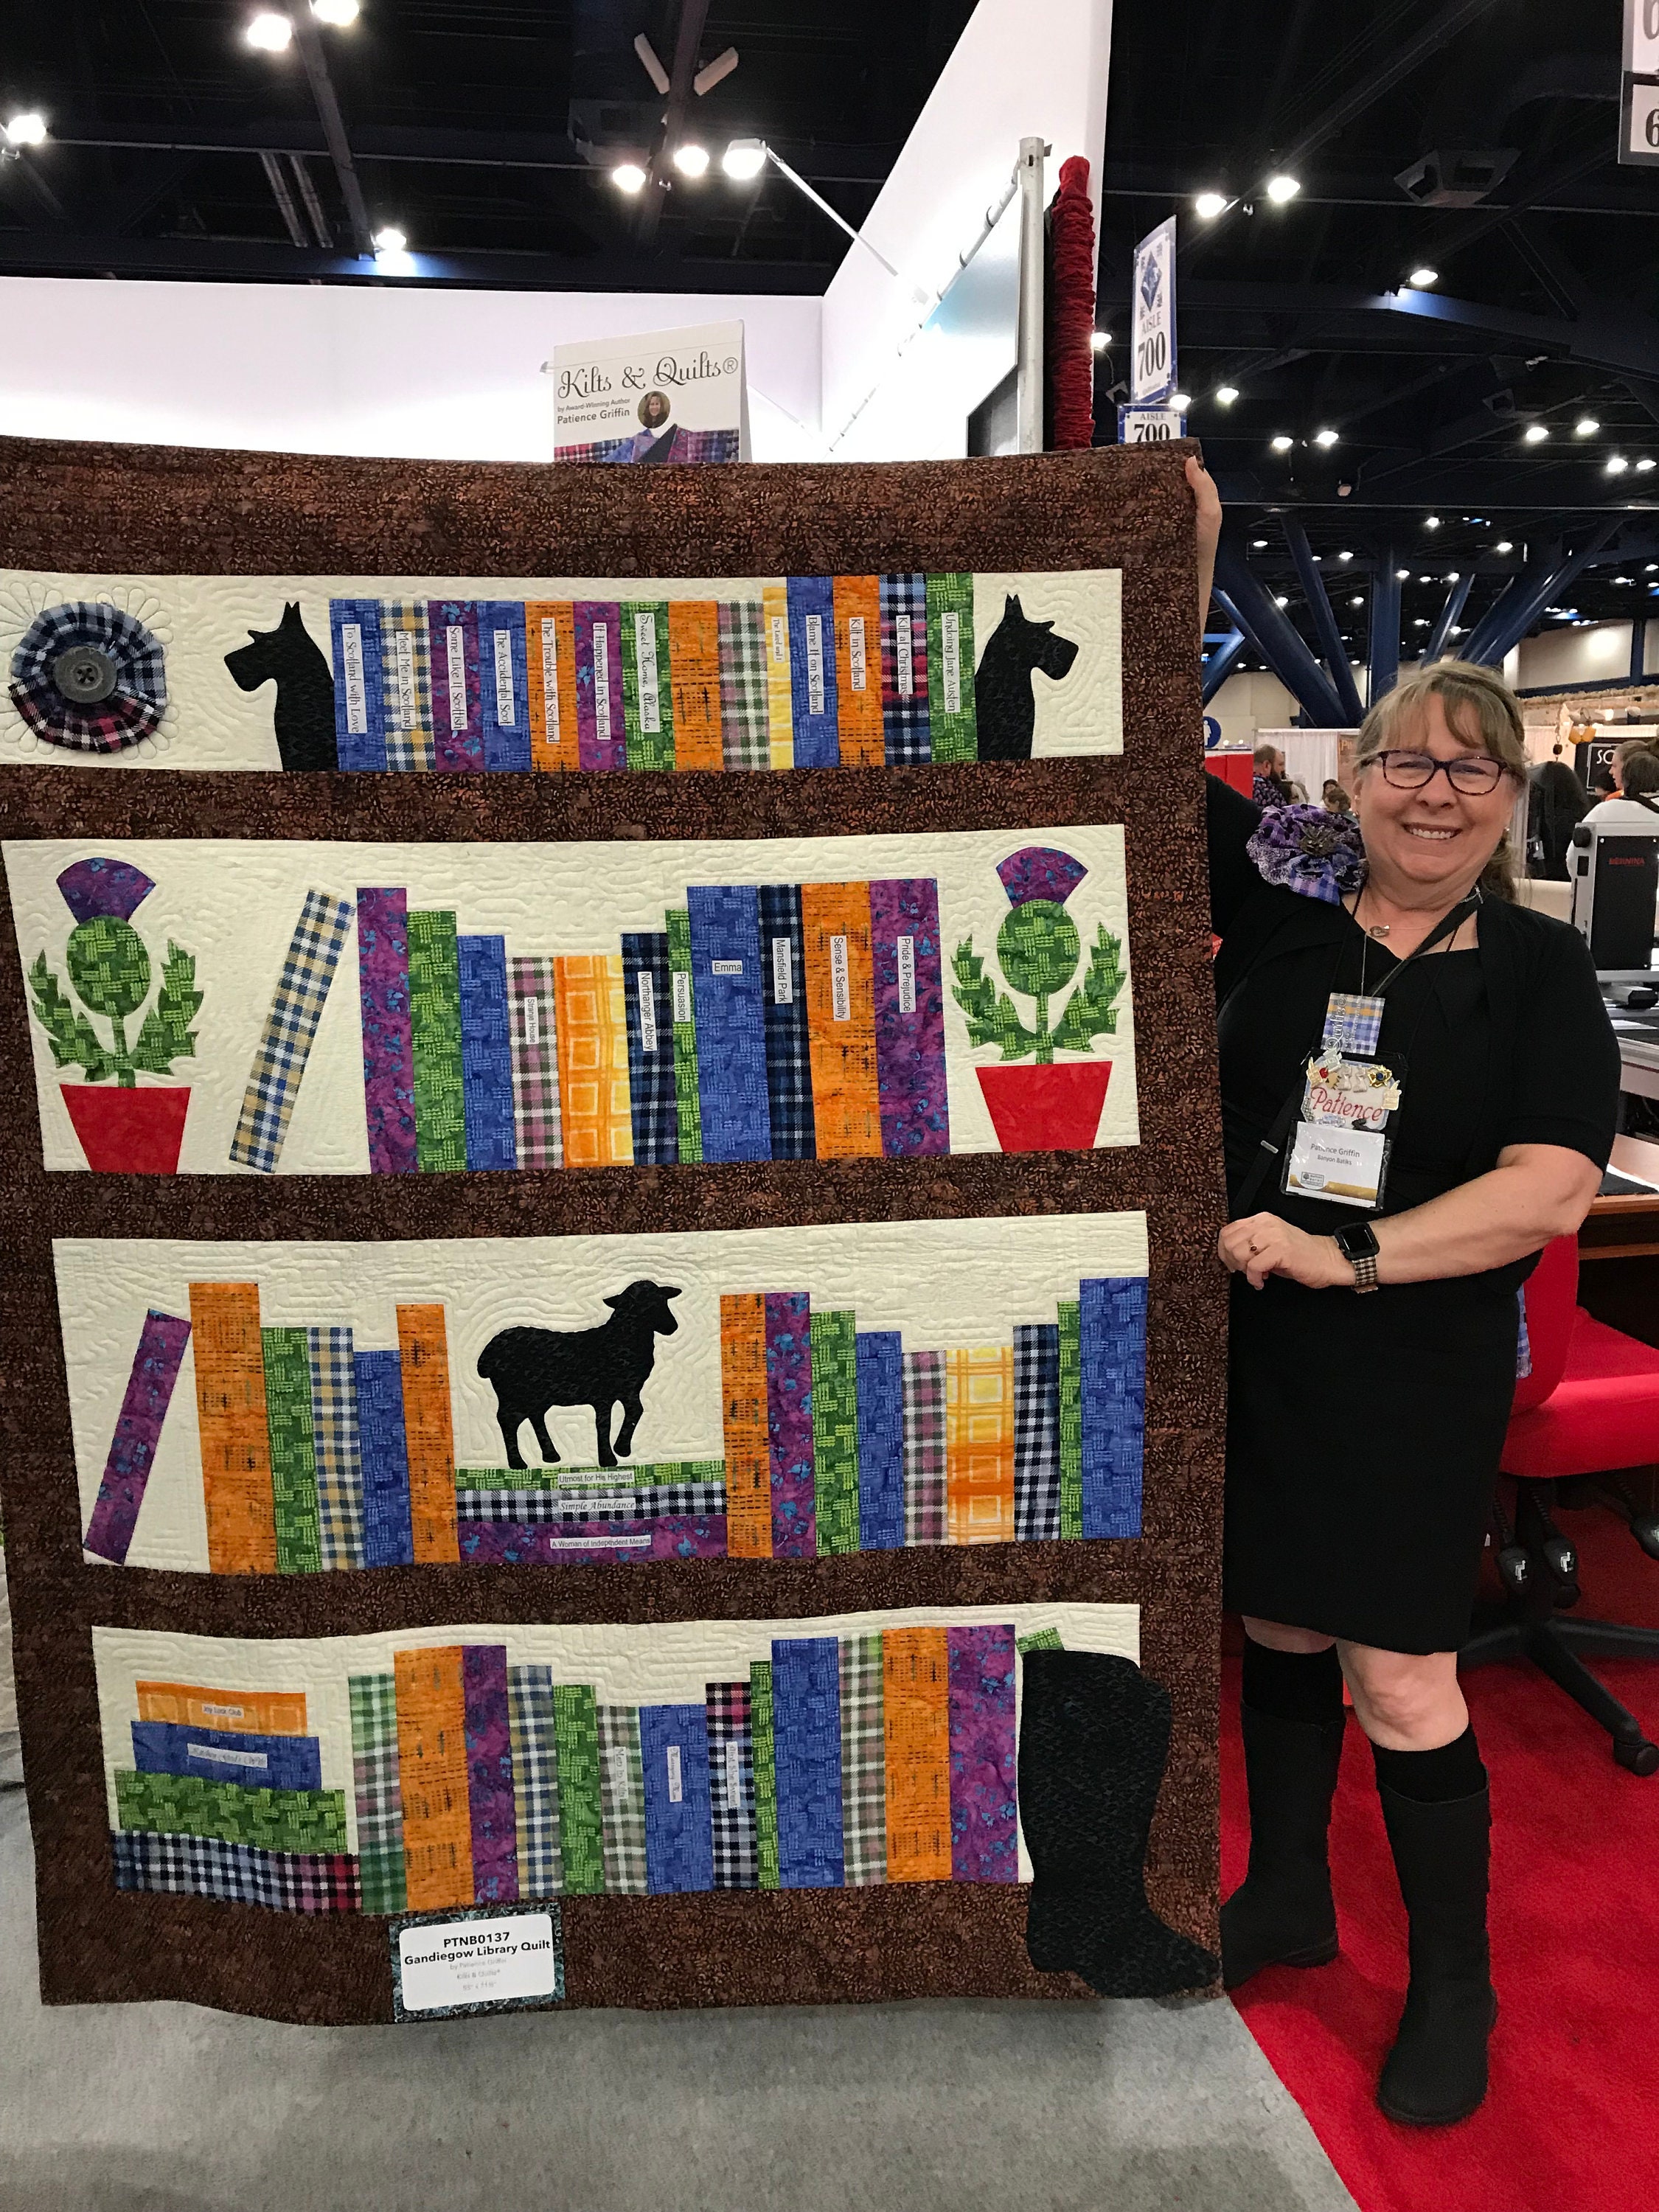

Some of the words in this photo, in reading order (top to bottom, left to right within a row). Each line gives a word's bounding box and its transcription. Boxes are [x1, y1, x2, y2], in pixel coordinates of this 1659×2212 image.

[1141, 310, 1161, 336] AISLE
[1138, 331, 1166, 382] 700
[557, 366, 611, 399] Kilts
[622, 366, 645, 389] &
[557, 413, 597, 424] Patience
[600, 408, 630, 419] Griffin
[566, 400, 609, 411] Award-Winning
[1134, 424, 1170, 442] 700
[344, 625, 356, 639] To
[541, 620, 553, 637] The
[639, 614, 653, 646] Sweet
[774, 630, 782, 645] Laird
[807, 616, 821, 646] Blame
[850, 619, 863, 634] Kilt
[897, 617, 910, 632] Kilt
[945, 614, 958, 653] Undoing
[398, 633, 411, 655] Meet
[449, 627, 459, 653] Some
[494, 631, 507, 648] The
[775, 646, 783, 658] and
[852, 639, 860, 647] in
[897, 636, 910, 644] at
[346, 642, 362, 681] Scotland
[400, 659, 411, 672] Me
[451, 657, 462, 678] Like
[543, 640, 557, 676] Trouble
[594, 636, 609, 683] Happened
[641, 651, 655, 688] Home,
[810, 659, 817, 671] on
[852, 651, 866, 690] Scotland
[945, 655, 956, 677] Jane
[498, 652, 512, 701] Accidental
[898, 648, 911, 695] Christmas
[348, 684, 361, 706] with
[544, 680, 557, 700] with
[596, 686, 607, 695] in
[809, 674, 824, 713] Scotland
[947, 680, 959, 712] Austen
[350, 709, 361, 732] Love
[401, 689, 417, 728] Scotland
[451, 693, 466, 728] Scottish
[499, 704, 512, 726] Scot
[597, 698, 611, 738] Scotland
[643, 692, 657, 730] Alaska
[546, 703, 560, 743] Scotland
[776, 939, 787, 980] Mansfield
[834, 937, 844, 965] Sense
[901, 938, 911, 961] Pride
[714, 963, 742, 973] Emma
[640, 973, 653, 1021] Northanger
[676, 973, 687, 1021] Persuasion
[778, 980, 787, 1002] Park
[835, 976, 846, 1019] Sensibility
[902, 972, 911, 1012] Prejudice
[644, 1023, 654, 1051] Abbey
[1310, 1087, 1382, 1121] Patience
[1338, 1148, 1360, 1158] Griffin
[559, 1474, 583, 1483] Utmost
[608, 1473, 633, 1482] Highest
[560, 1501, 588, 1512] Simple
[588, 1500, 635, 1511] Abundance
[404, 1950, 474, 1965] Gandiegow
[477, 1944, 518, 1957] Library
[521, 1939, 551, 1951] Quilt
[443, 1932, 510, 1948] PTNB0137
